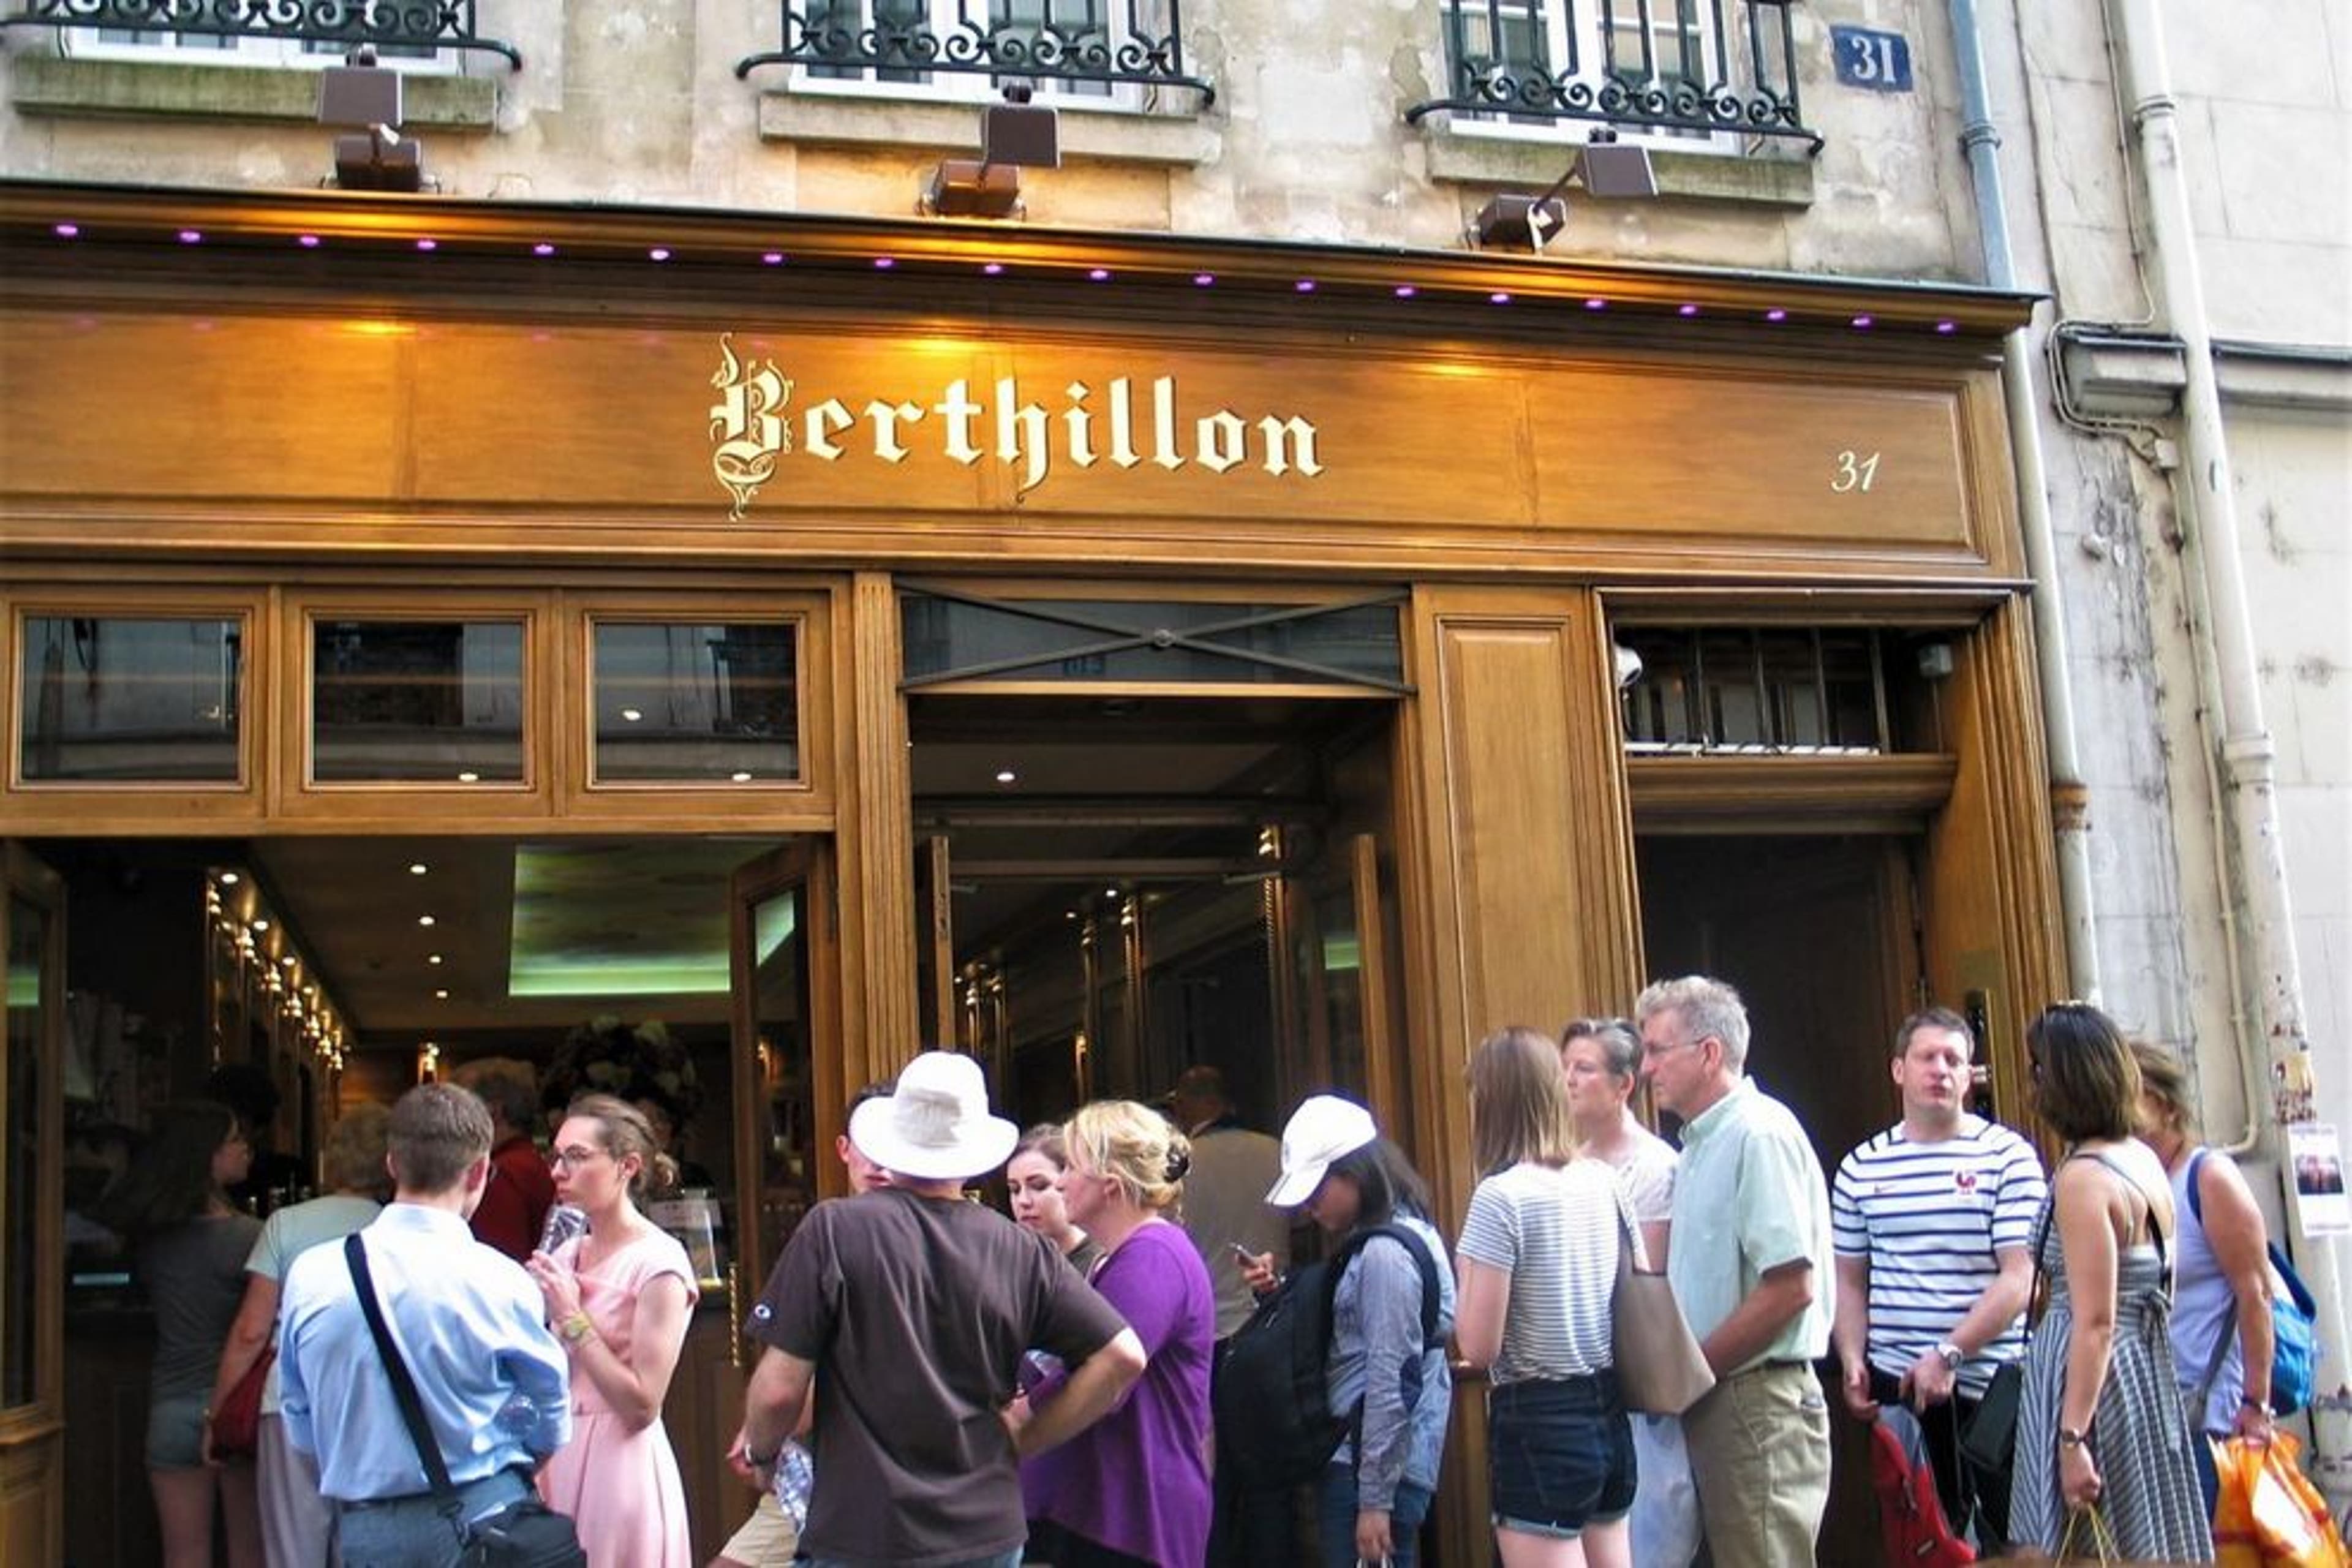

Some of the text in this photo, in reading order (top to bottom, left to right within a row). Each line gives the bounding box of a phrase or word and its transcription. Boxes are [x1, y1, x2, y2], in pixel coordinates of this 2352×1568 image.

[1852, 35, 1896, 84] 31
[710, 331, 1324, 521] Berthillon
[1831, 450, 1880, 491] 31
